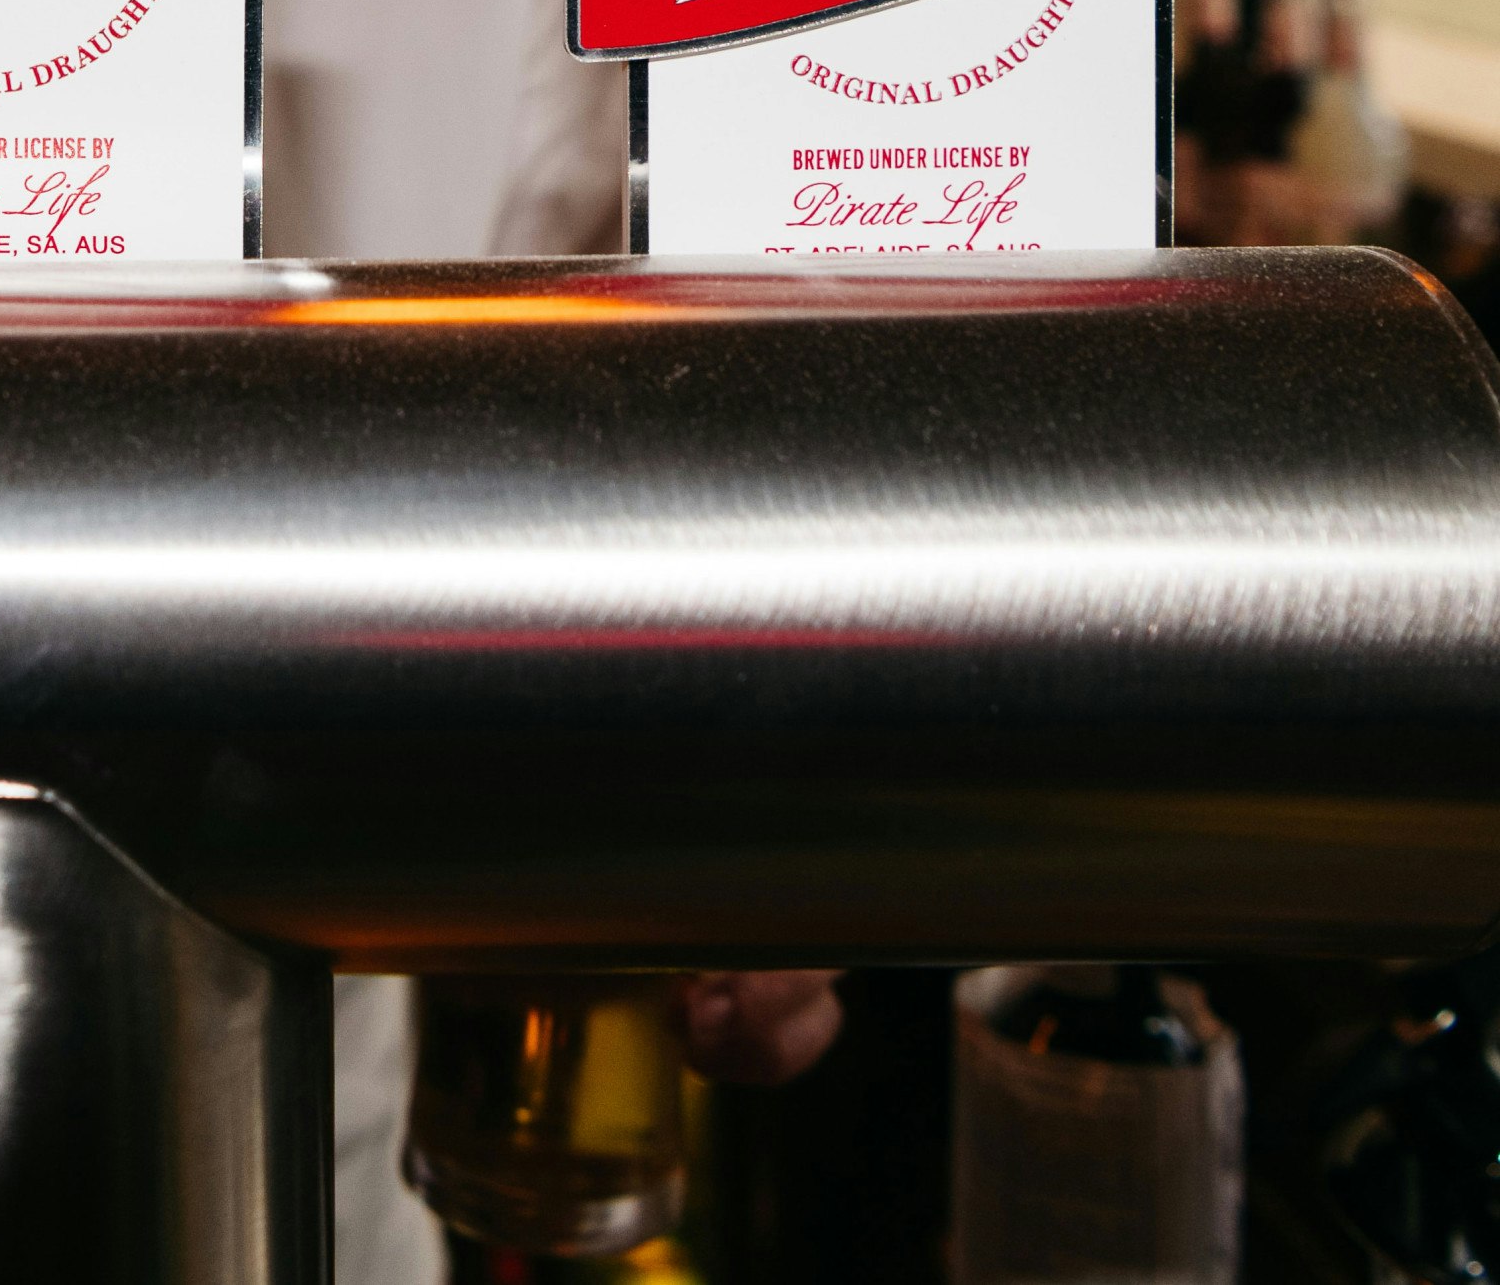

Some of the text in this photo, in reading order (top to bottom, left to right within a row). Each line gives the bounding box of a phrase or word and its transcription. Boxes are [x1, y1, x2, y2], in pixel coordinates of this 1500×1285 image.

[790, 54, 942, 105] ORIGINAL
[14, 137, 86, 159] LICENSE
[92, 137, 114, 159] BY
[792, 146, 1030, 171] BREWED UNDER LICENSE BY
[1, 164, 111, 238] Life
[785, 172, 1027, 246] Pirate Life
[27, 235, 66, 254] SA.
[75, 235, 125, 254] AUS
